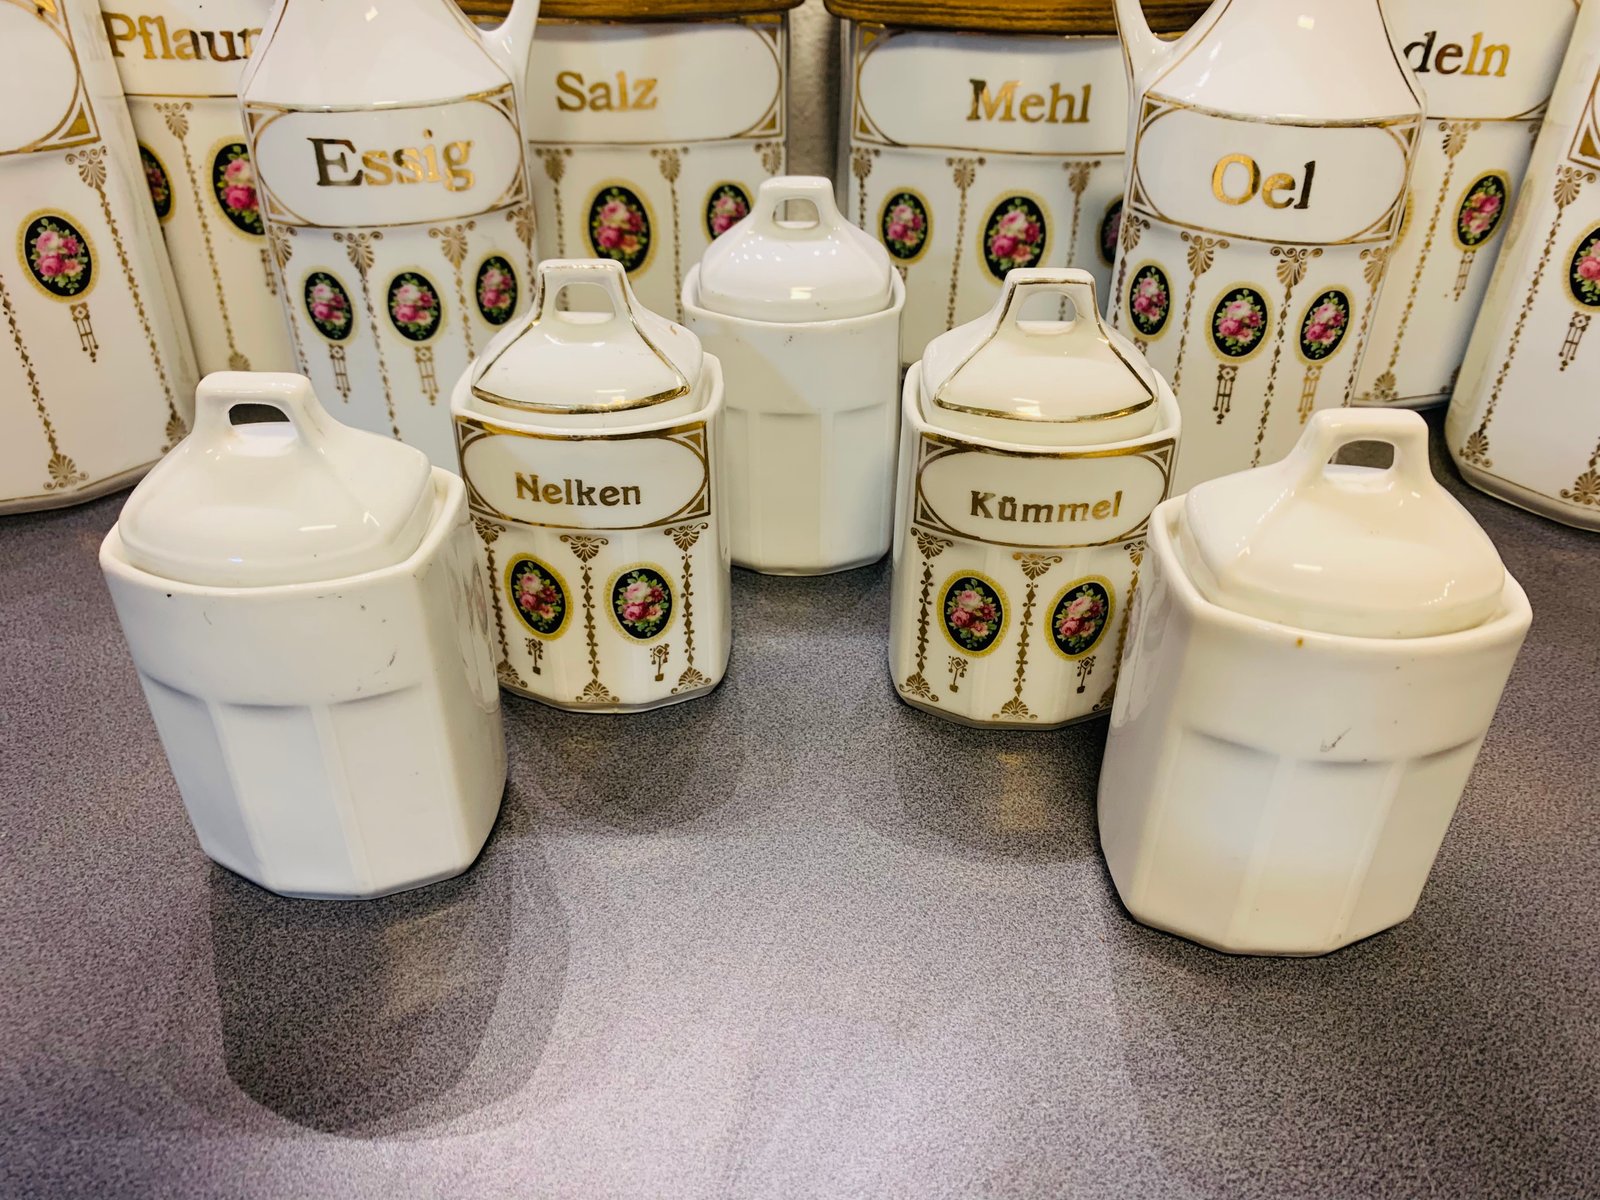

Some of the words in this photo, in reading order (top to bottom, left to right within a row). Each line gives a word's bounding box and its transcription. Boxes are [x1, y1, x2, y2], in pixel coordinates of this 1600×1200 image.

[556, 70, 658, 112] Salz
[966, 78, 1092, 124] Mehl
[306, 128, 476, 192] Essig
[1211, 152, 1316, 210] Oel
[514, 472, 641, 506] Nelken
[970, 490, 1123, 523] Kümmel
